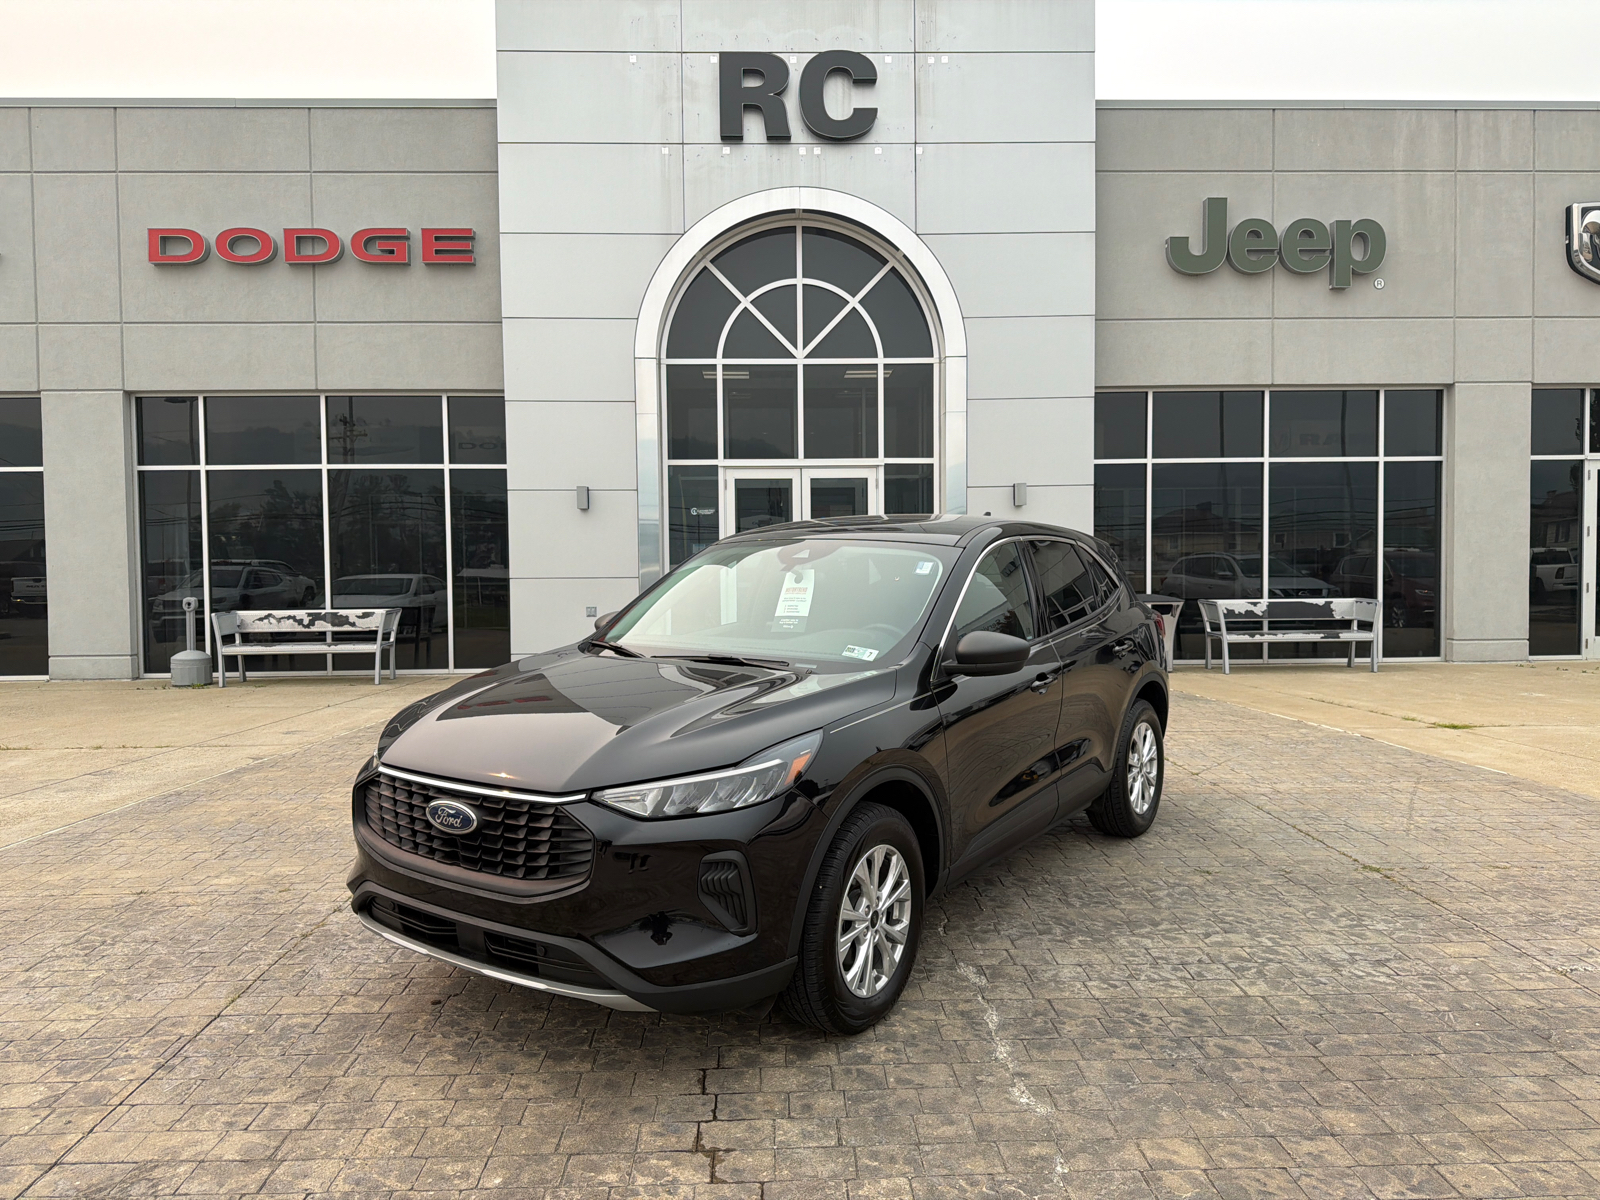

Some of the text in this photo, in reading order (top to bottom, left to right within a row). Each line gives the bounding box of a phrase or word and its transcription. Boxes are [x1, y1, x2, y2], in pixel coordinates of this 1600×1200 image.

[718, 49, 878, 141] RC
[147, 227, 476, 266] DODGE
[1165, 196, 1387, 290] Jeep
[434, 806, 464, 828] Ford
